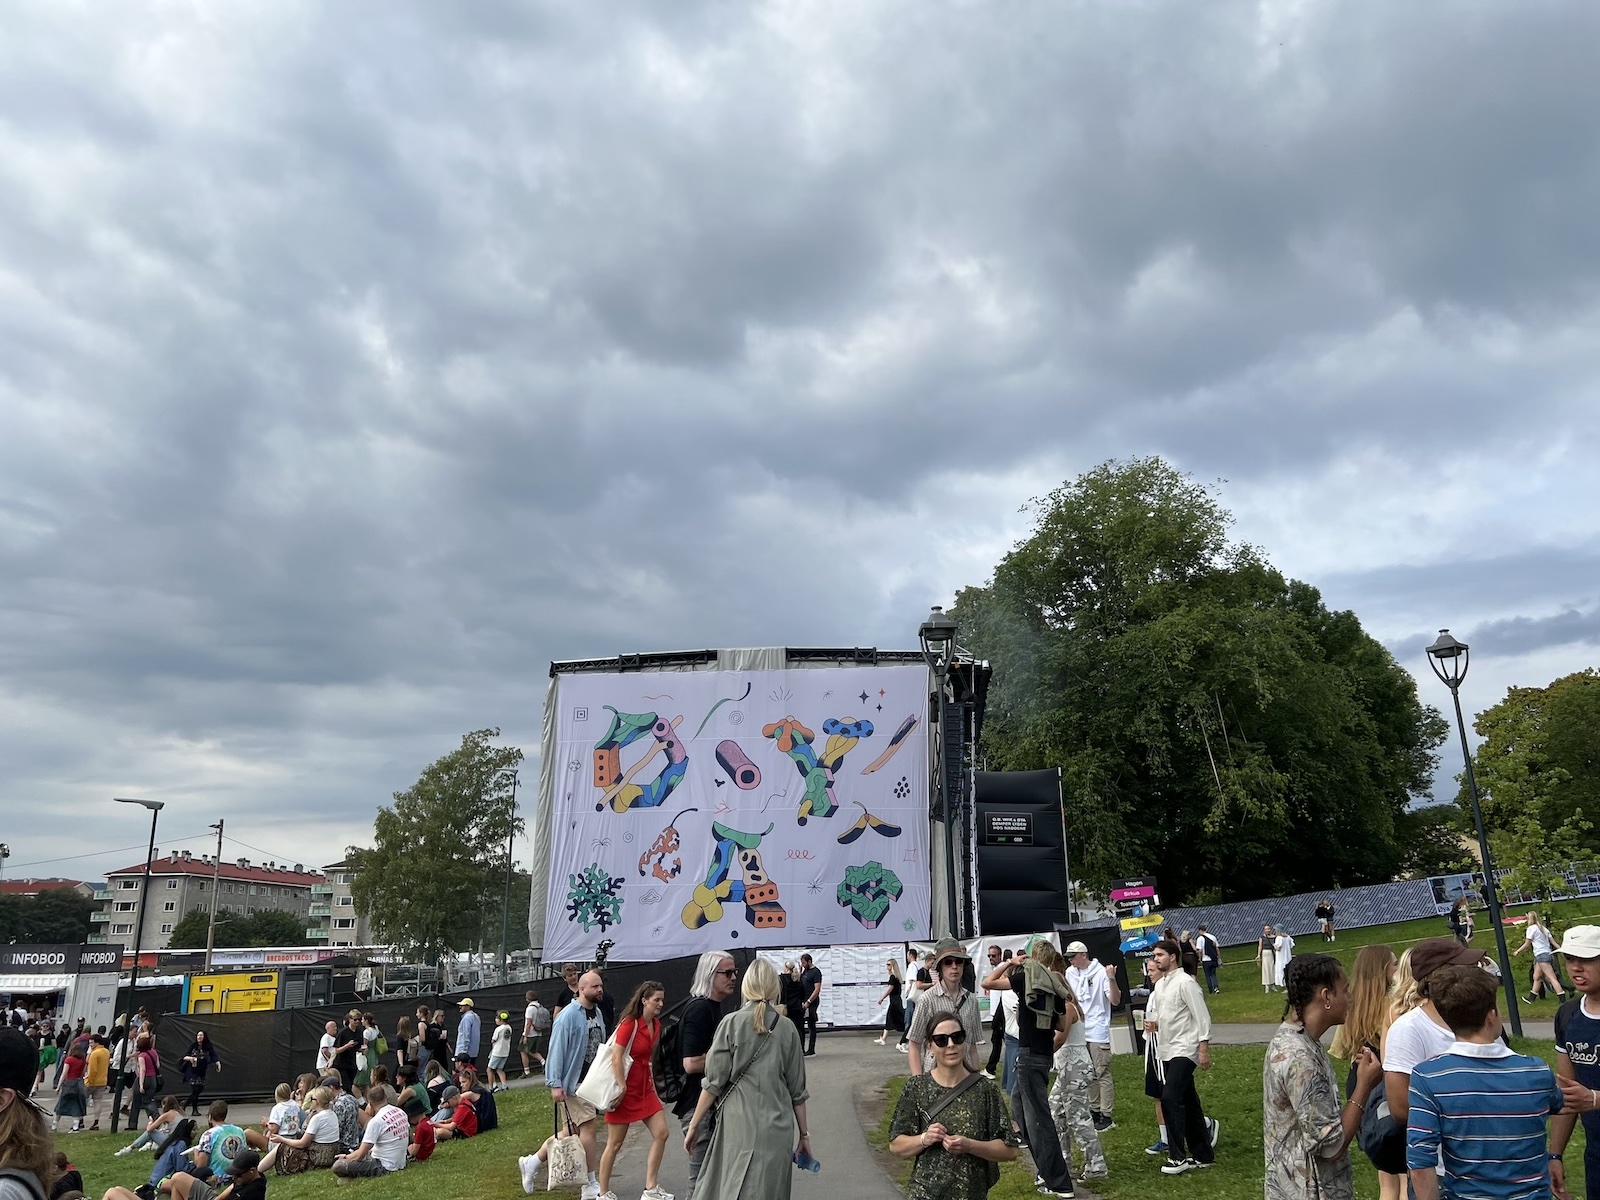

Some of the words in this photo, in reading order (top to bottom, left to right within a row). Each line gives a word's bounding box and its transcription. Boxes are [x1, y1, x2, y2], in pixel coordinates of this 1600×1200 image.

[1129, 939, 1148, 948] Utgang
[12, 953, 65, 965] INFOBOD
[81, 952, 116, 964] INFOBOD
[266, 954, 293, 962] BREDDOS
[1575, 1042, 1589, 1052] The
